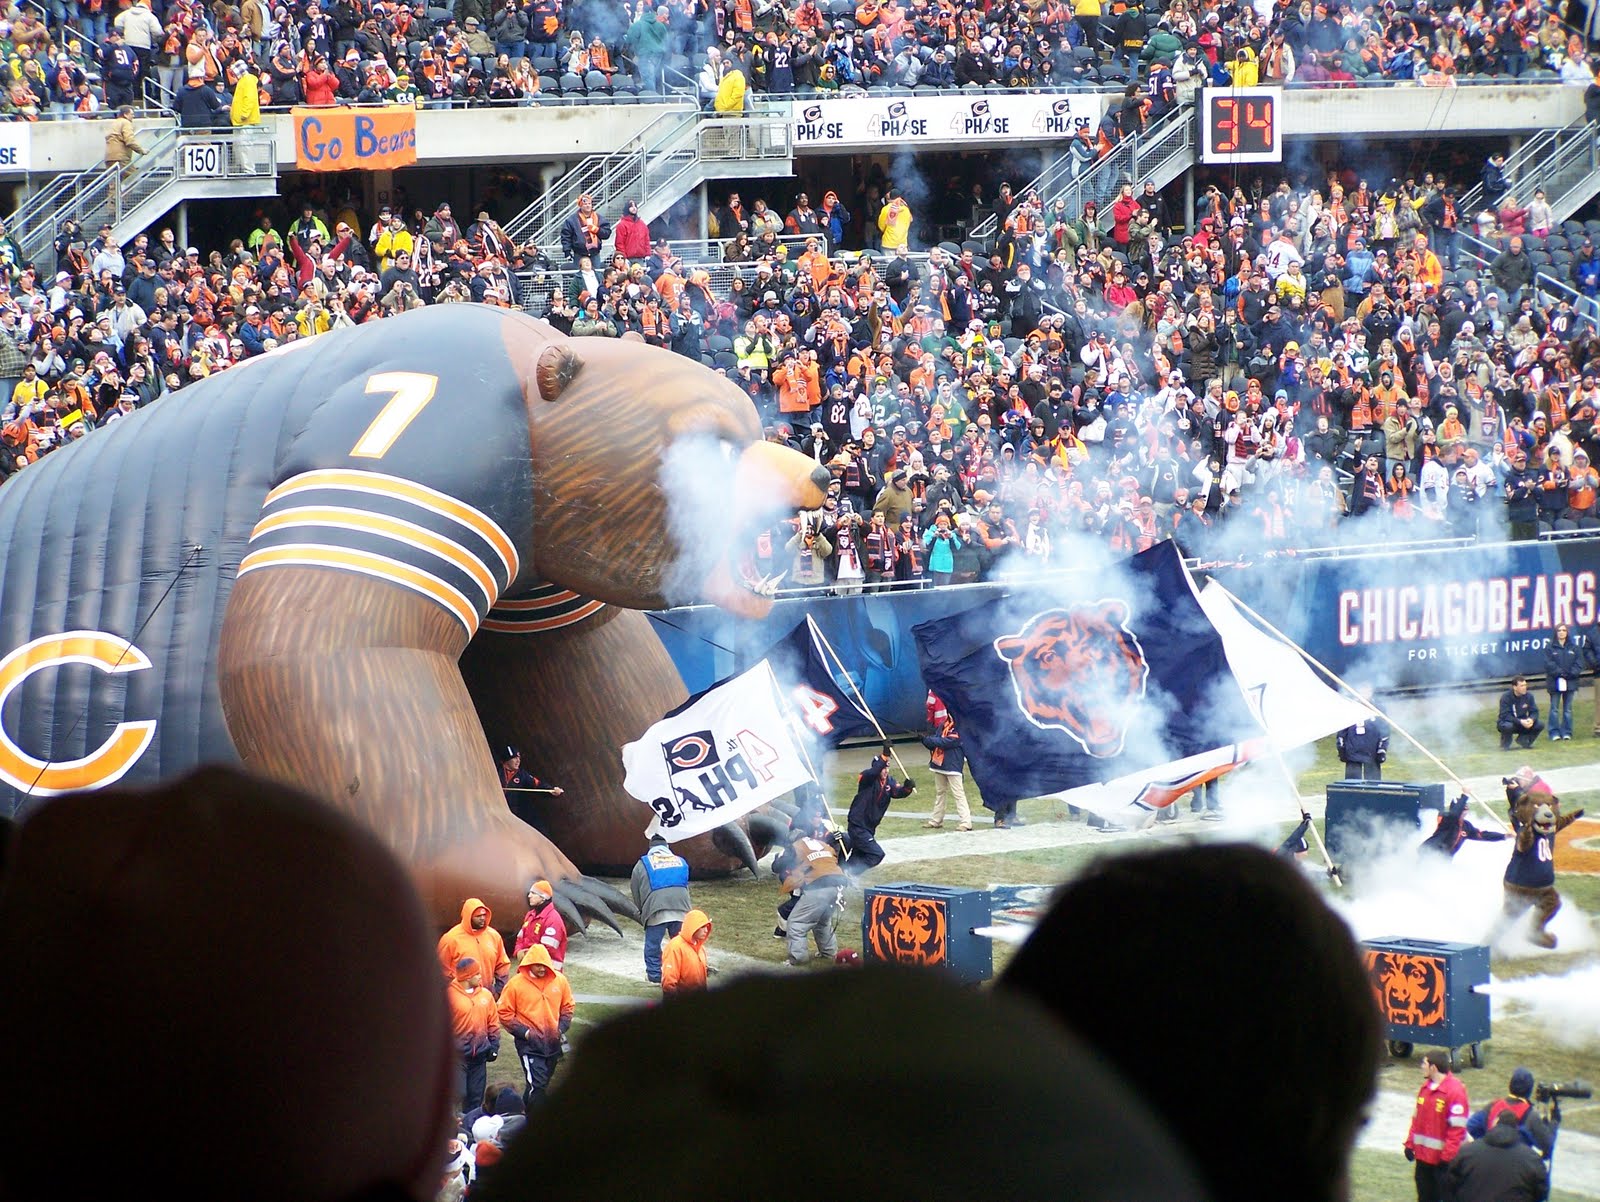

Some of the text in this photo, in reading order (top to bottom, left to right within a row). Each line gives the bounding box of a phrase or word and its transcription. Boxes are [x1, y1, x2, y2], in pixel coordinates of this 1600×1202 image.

[311, 23, 325, 39] 34
[114, 50, 129, 65] 51
[774, 51, 789, 68] 22
[1149, 77, 1158, 95] 51
[881, 119, 927, 136] PHASE
[965, 117, 1010, 134] PHASE
[1216, 100, 1272, 150] 34
[301, 116, 416, 162] Go Bears
[188, 148, 216, 172] 150
[1169, 264, 1184, 283] 54
[348, 371, 439, 459] 7
[830, 403, 847, 424] 82
[1337, 571, 1600, 646] CHICAGOBEARS
[1408, 634, 1587, 661] FOR TICKET INFORTI
[0, 630, 157, 797] C
[791, 683, 840, 736] 4
